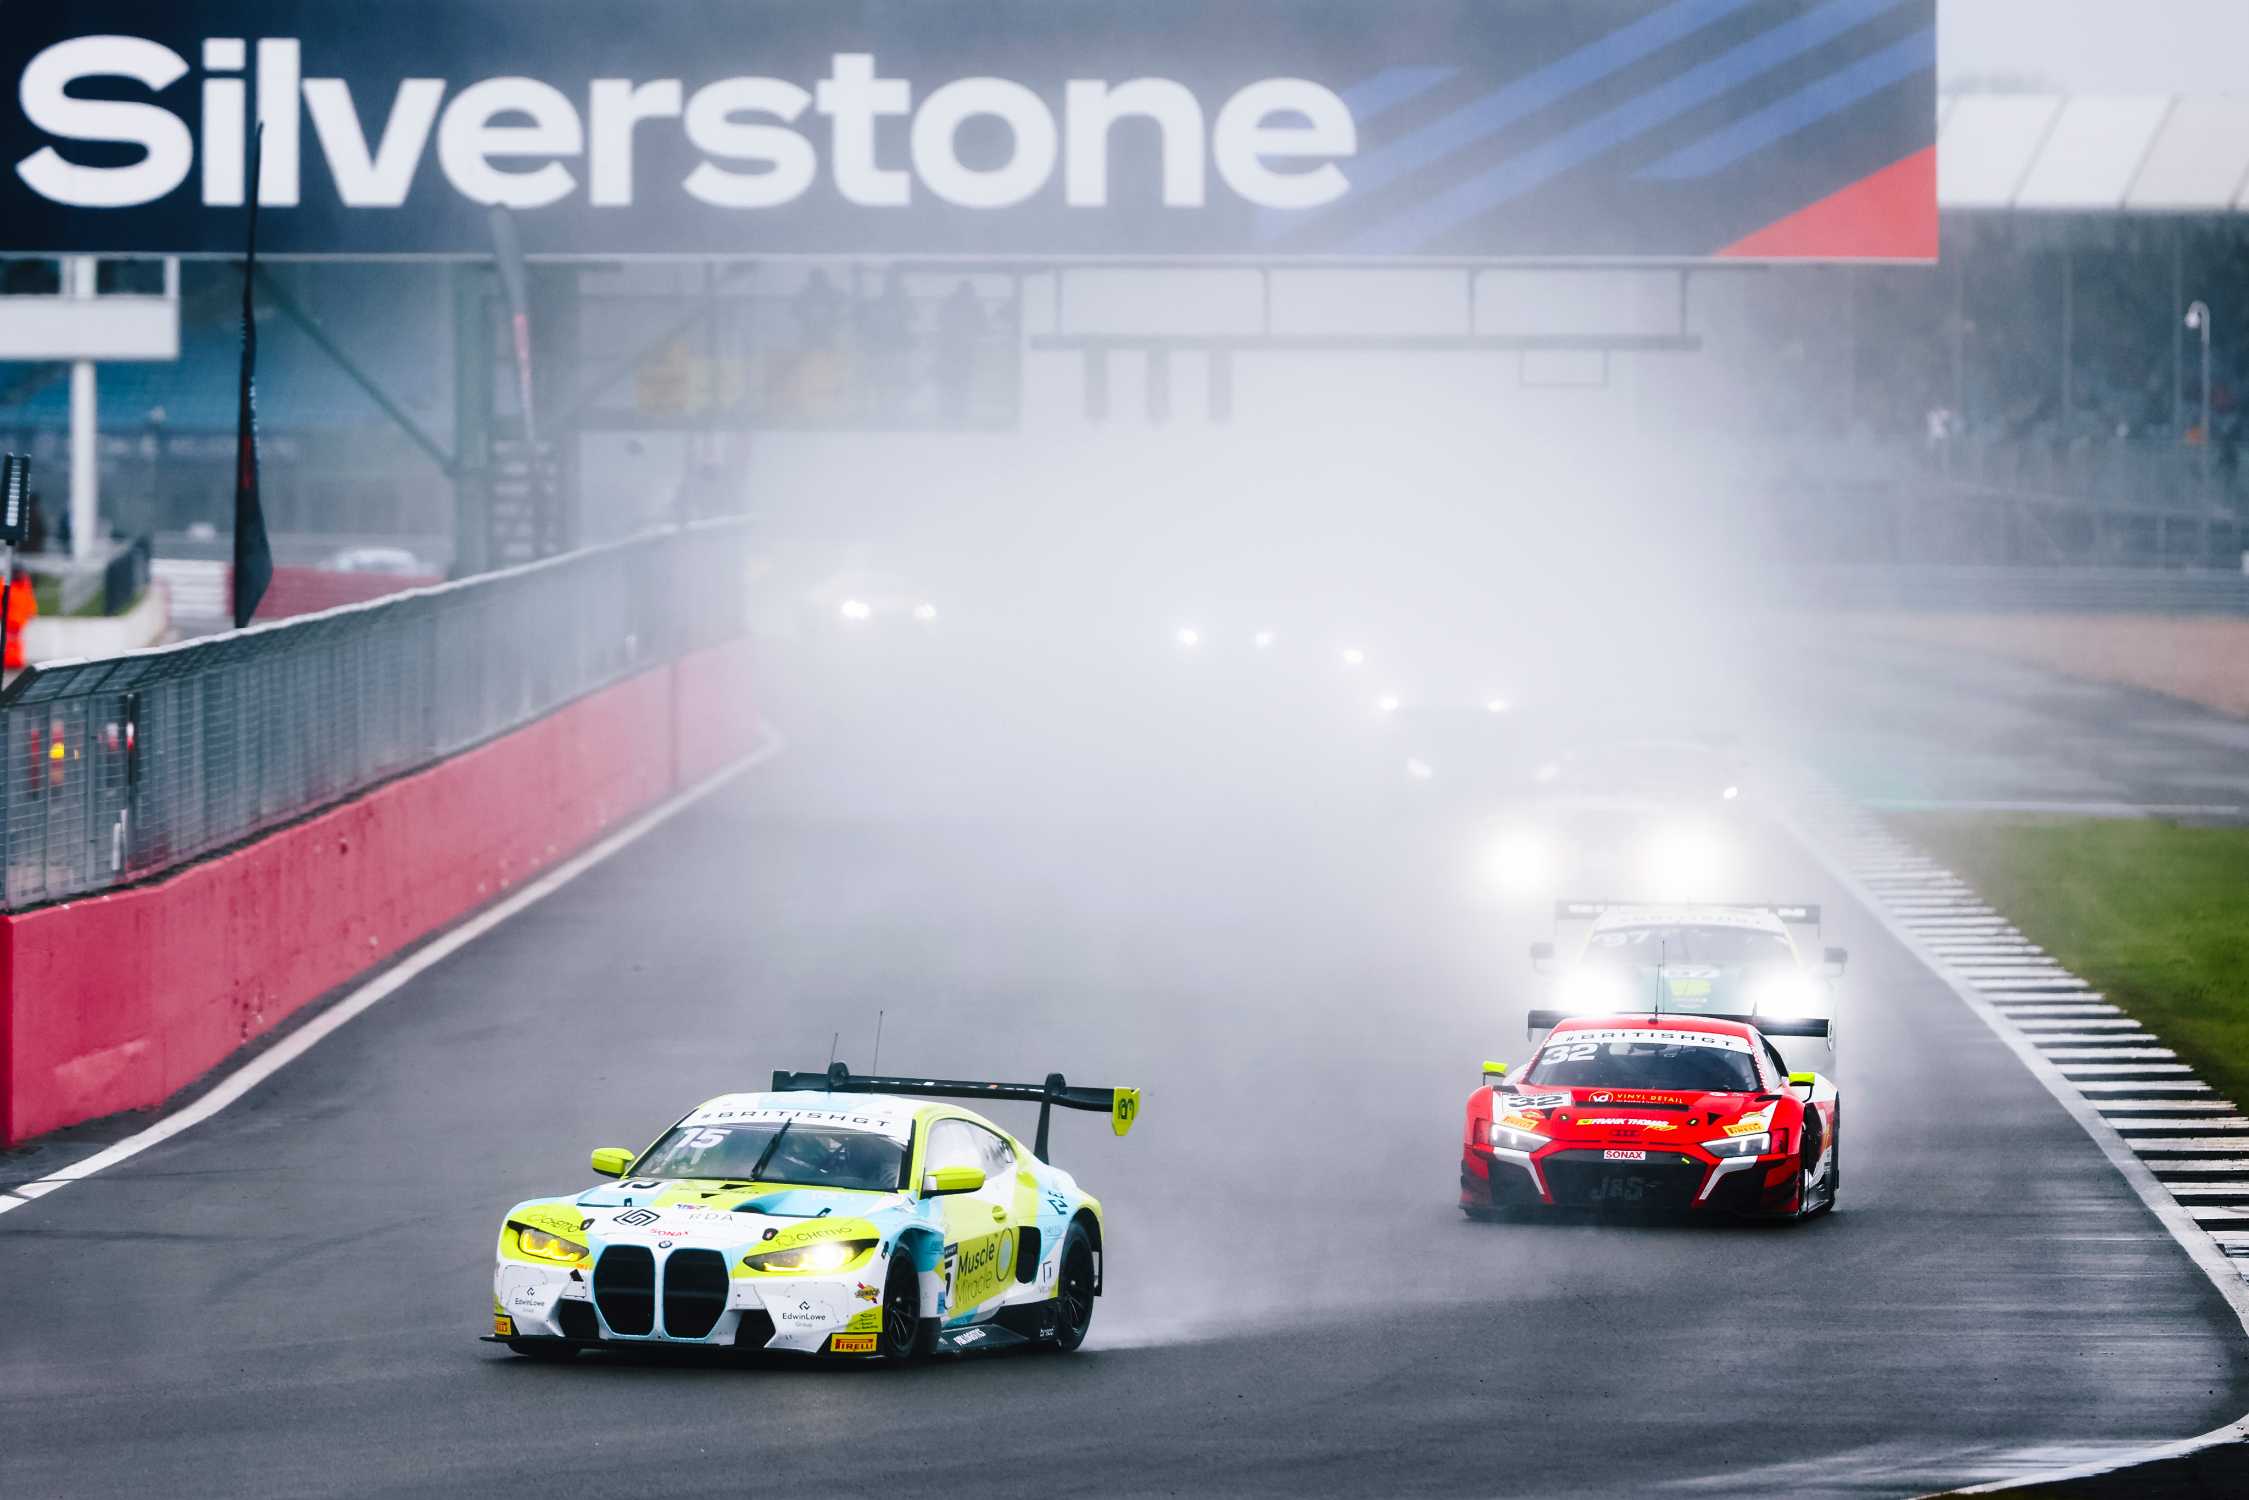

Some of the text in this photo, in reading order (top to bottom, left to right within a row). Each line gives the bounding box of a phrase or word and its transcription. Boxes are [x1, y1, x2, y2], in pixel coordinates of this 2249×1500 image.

[16, 34, 1358, 208] Silverstone
[1565, 1031, 1734, 1047] #BRITISHGT
[1541, 1043, 1599, 1065] 32
[1508, 1095, 1564, 1108] 32
[1650, 1095, 1683, 1104] DETAIL
[702, 1110, 892, 1127] #BRITISHGT
[675, 1127, 733, 1149] 15
[1605, 1150, 1643, 1159] SONAX
[957, 1238, 995, 1281] Muscle
[782, 1312, 826, 1321] EdwinLowe
[835, 1338, 874, 1350] PIRELLI
